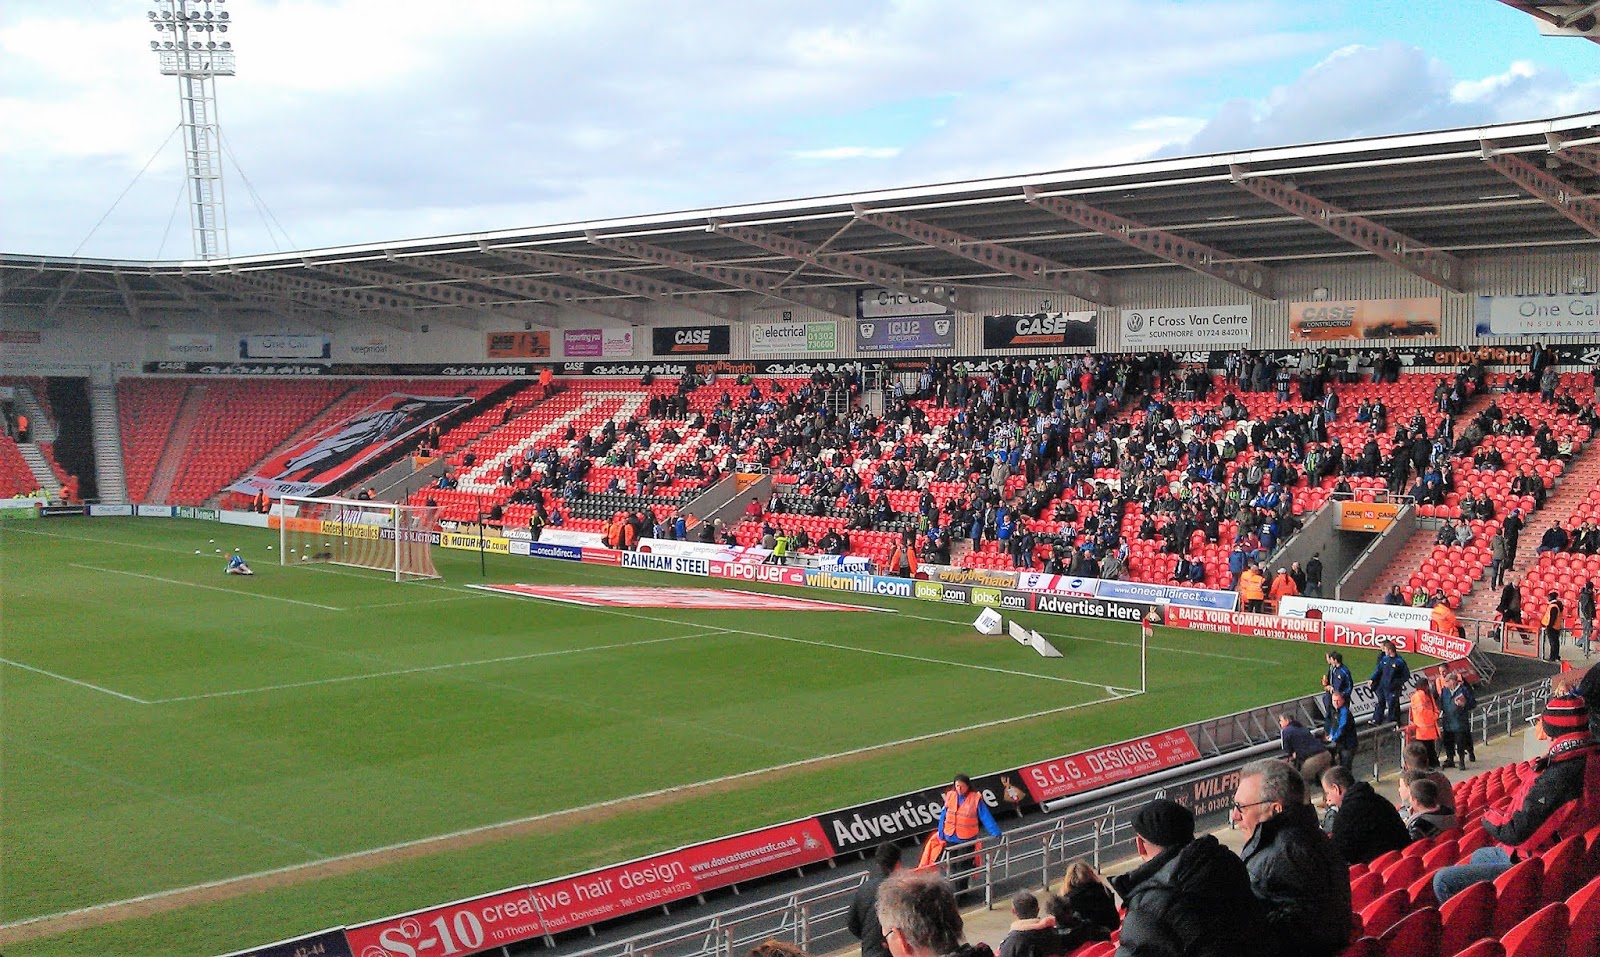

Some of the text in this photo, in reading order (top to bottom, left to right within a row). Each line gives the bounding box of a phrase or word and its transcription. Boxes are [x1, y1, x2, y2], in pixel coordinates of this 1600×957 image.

[1302, 306, 1356, 320] CASE
[1519, 299, 1599, 317] One Cal
[888, 320, 920, 335] ICU2
[1015, 317, 1068, 335] CASE
[1149, 314, 1248, 327] F Cross Van Centre
[1306, 320, 1351, 328] CONSTRUCTION
[675, 329, 711, 345] CASE
[765, 324, 806, 338] electrical
[808, 332, 834, 341] 01302
[1149, 330, 1194, 338] SCUNTHORPE
[1221, 328, 1248, 336] 842011
[1173, 351, 1211, 363] CASE
[564, 362, 585, 371] CASE
[623, 552, 672, 570] RAINHAM
[675, 558, 708, 574] STEEL
[820, 562, 866, 573] BRIGHTON
[917, 565, 936, 575] ASE
[723, 562, 788, 582] npower
[805, 572, 910, 597] williamhill.com
[1038, 596, 1141, 620] Advertise Here
[1306, 602, 1354, 616] keepmoat
[1179, 608, 1320, 633] RAISE YOUR COMPANY PROFILE
[1388, 610, 1431, 623] keepmo
[1188, 621, 1231, 633] ADVERTISE HERE
[1253, 628, 1267, 637] CALL
[1267, 630, 1285, 639] 01302
[1333, 624, 1407, 649] Pinders
[1421, 632, 1466, 652] digital print
[1420, 643, 1436, 655] 0800
[1085, 741, 1158, 774] DESIGNS
[1194, 770, 1240, 801] WILFR
[1208, 796, 1229, 812] 01302
[833, 800, 942, 847] Advertise
[482, 861, 685, 923] creative hair design
[492, 930, 505, 940] 10
[504, 921, 538, 937] Thorne
[570, 903, 614, 922] Doncaster
[635, 889, 661, 903] 01302
[662, 881, 692, 896] 341273
